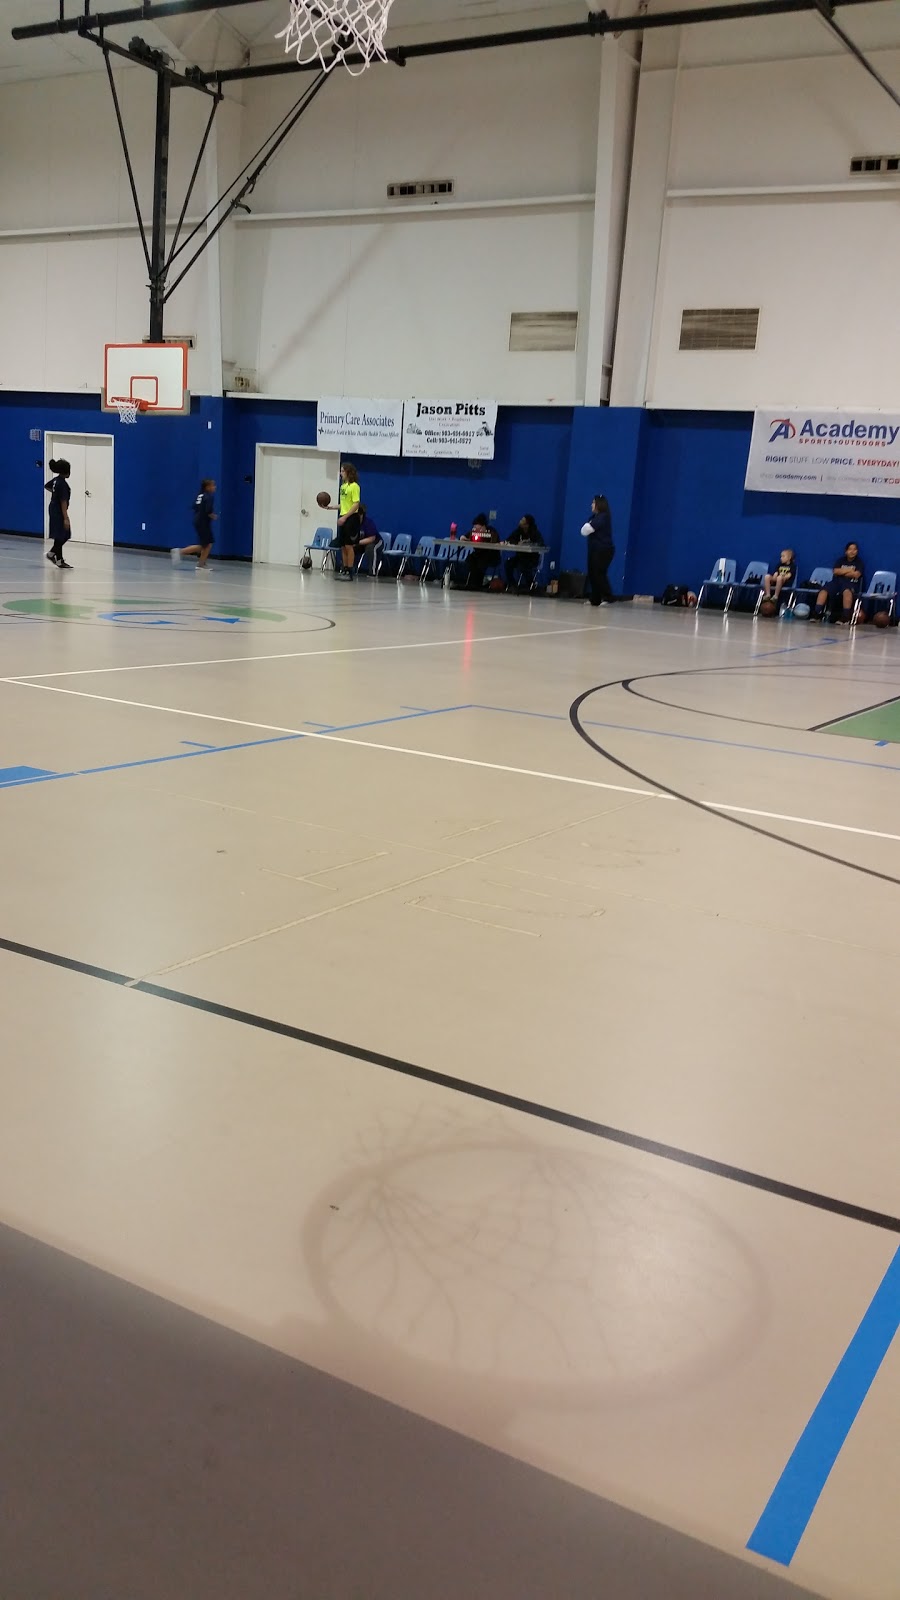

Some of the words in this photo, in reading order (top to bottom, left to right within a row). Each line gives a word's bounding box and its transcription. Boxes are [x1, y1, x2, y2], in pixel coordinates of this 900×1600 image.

[416, 402, 453, 418] Jason
[455, 403, 486, 416] Pitts
[320, 411, 344, 428] Primary
[345, 412, 361, 426] Care
[361, 413, 395, 427] Associates
[799, 419, 900, 445] Academy
[765, 455, 789, 463] RIGHT
[830, 457, 855, 466] PRICE.
[856, 458, 900, 468] EVERYDAY!
[774, 473, 817, 481] academy.com
